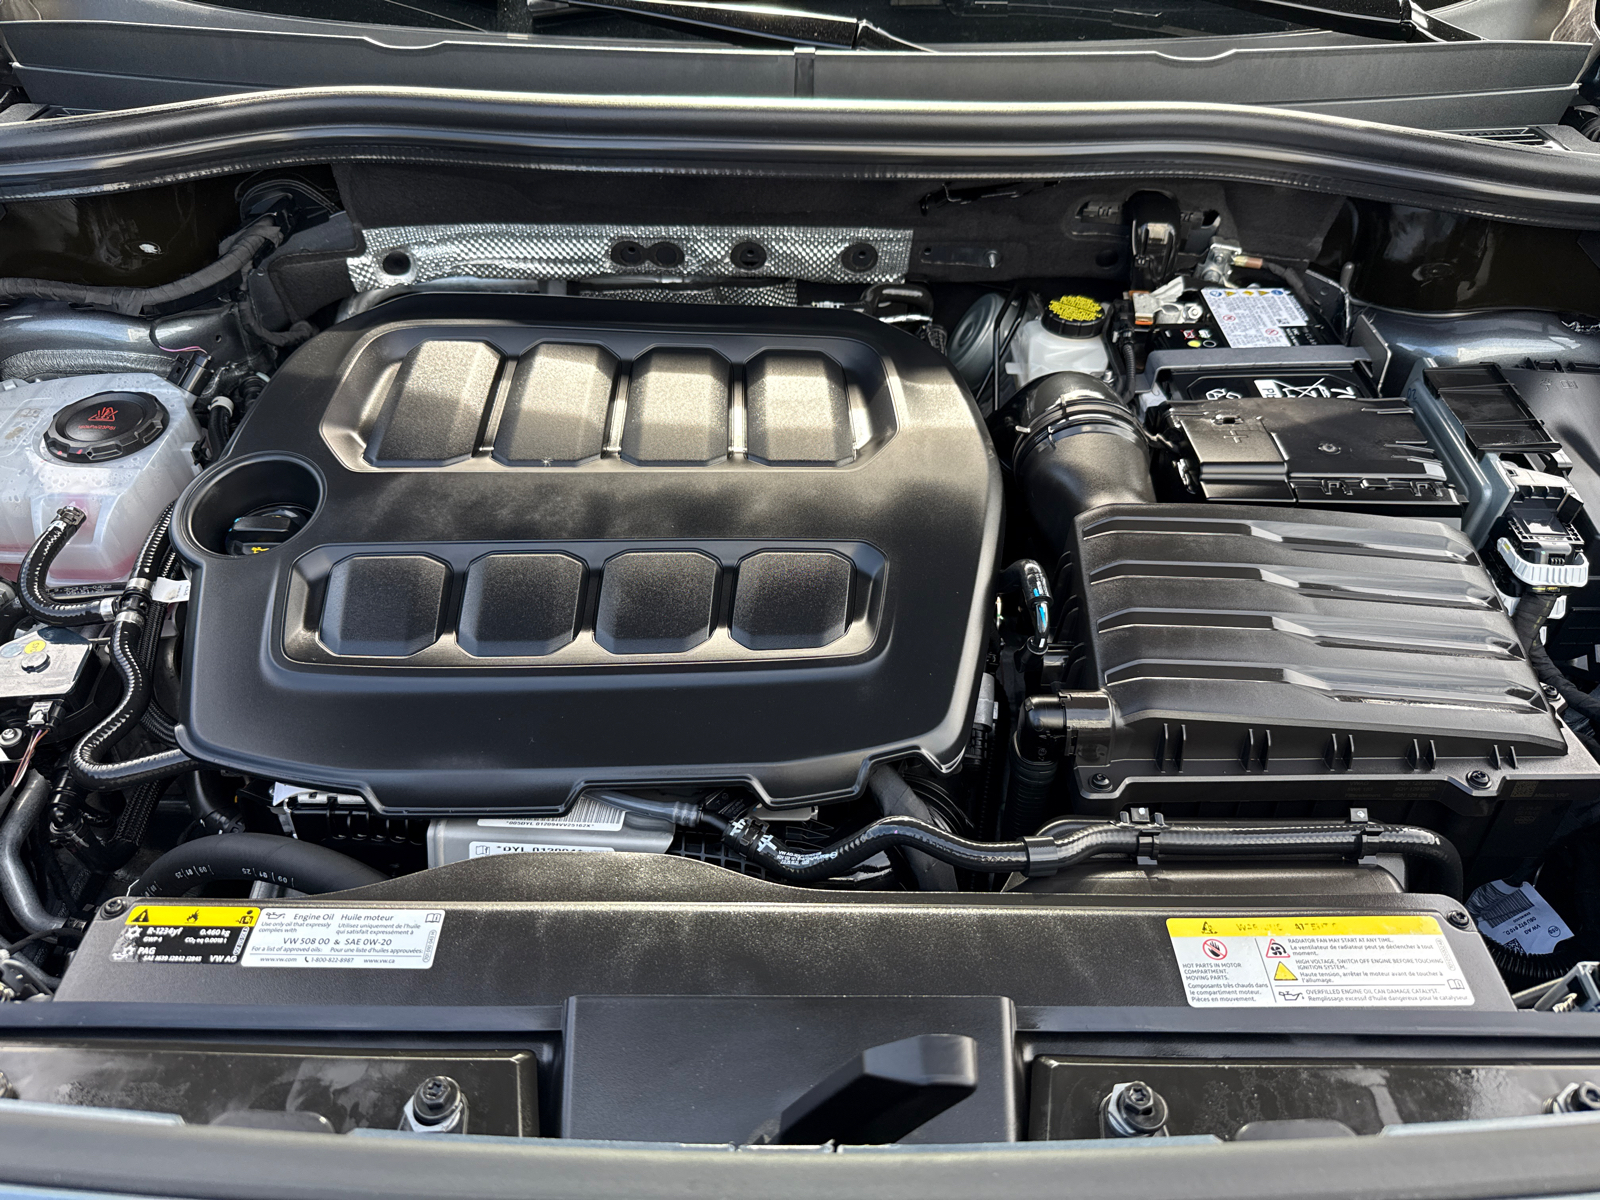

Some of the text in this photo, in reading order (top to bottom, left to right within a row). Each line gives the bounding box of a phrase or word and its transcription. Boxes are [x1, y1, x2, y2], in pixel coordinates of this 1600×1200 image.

[146, 927, 183, 937] R-1234yf
[220, 929, 231, 937] kg
[137, 946, 156, 955] PAG
